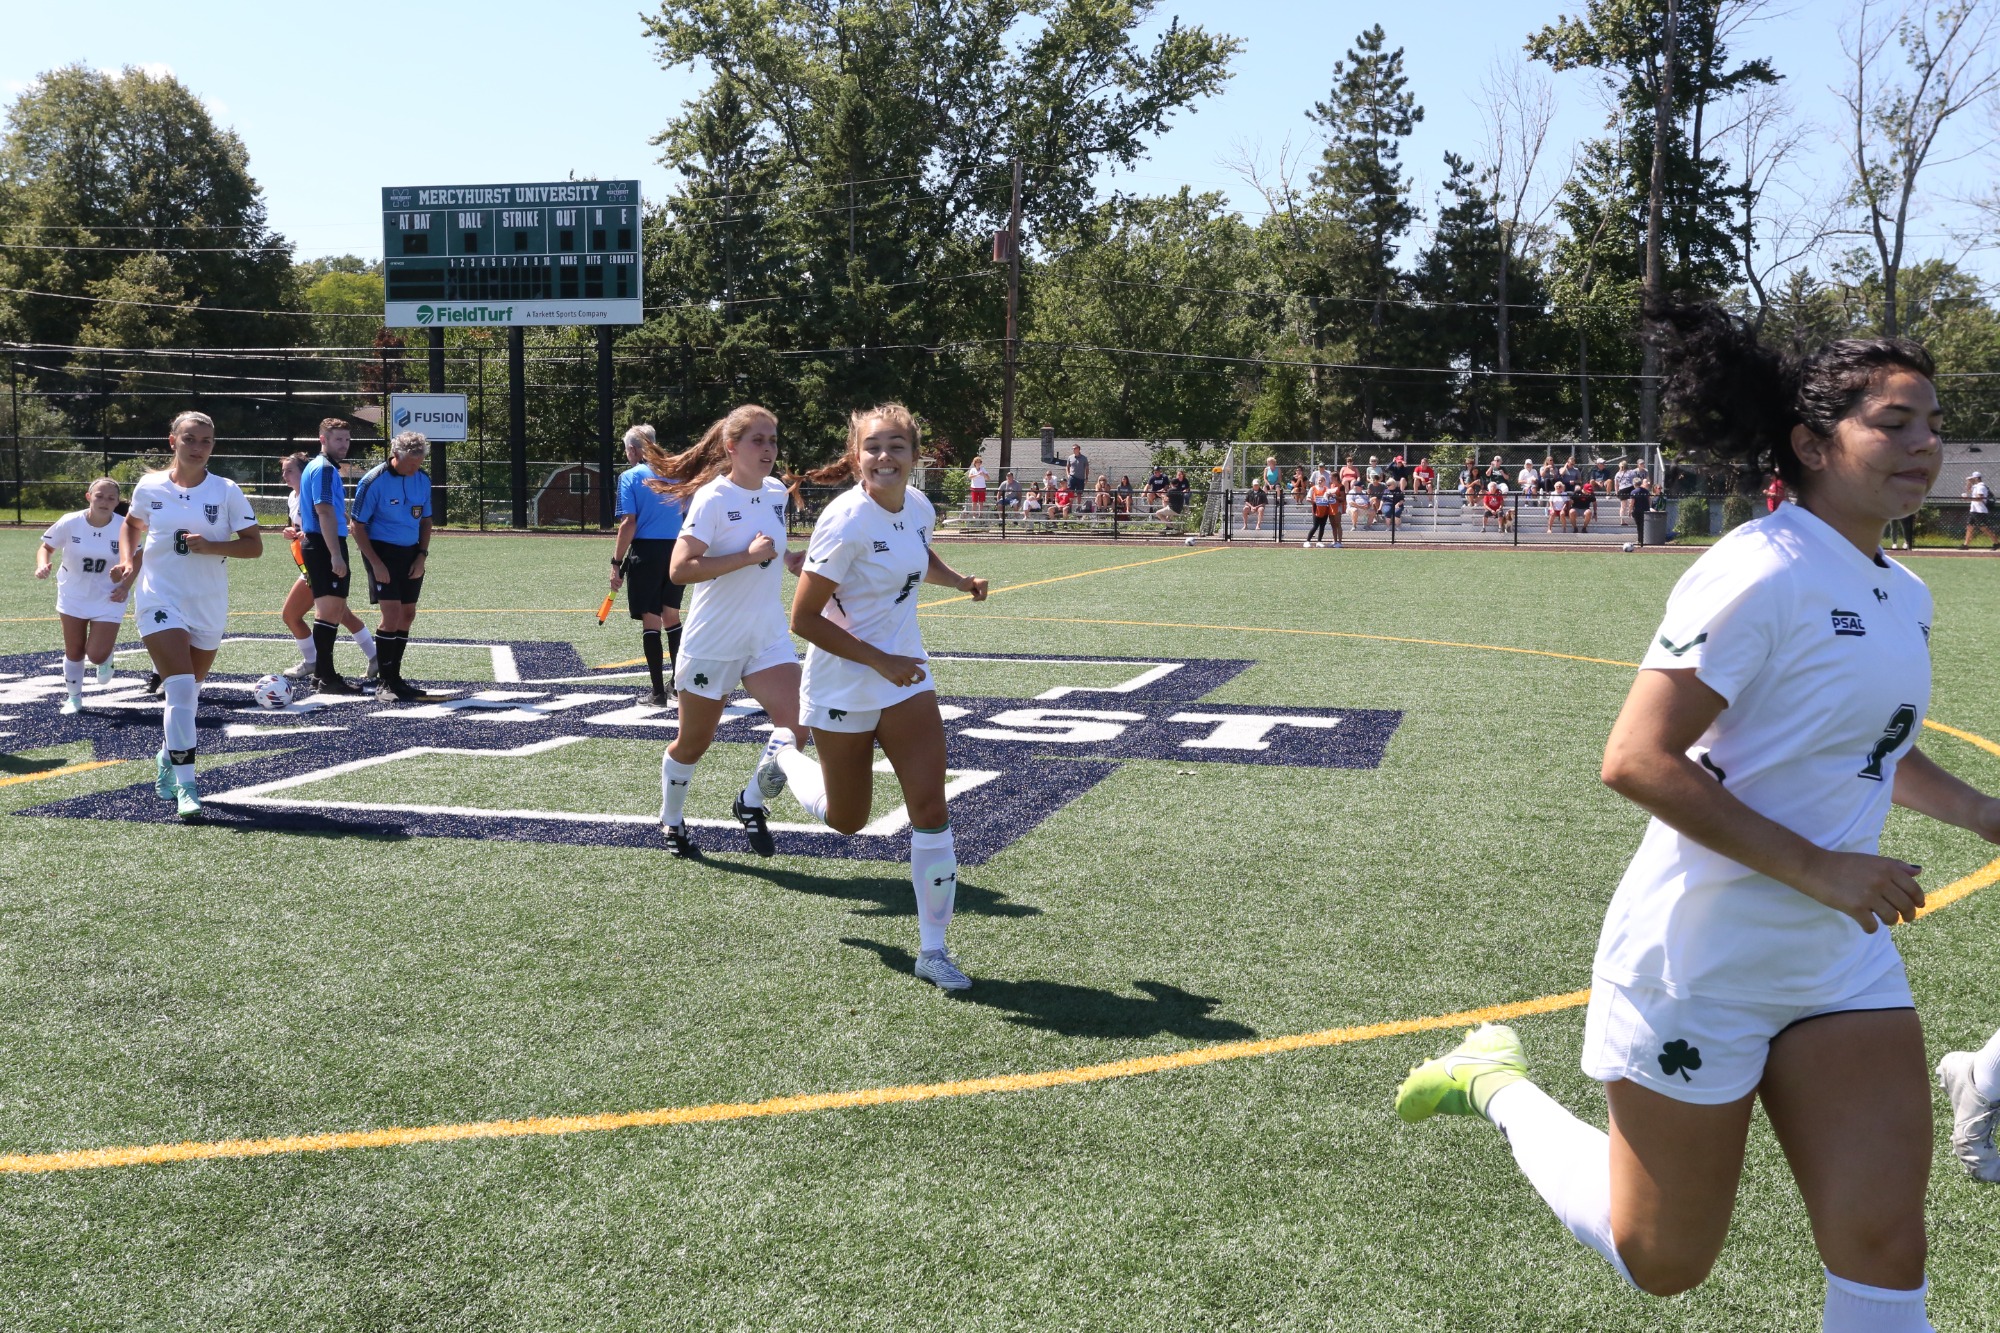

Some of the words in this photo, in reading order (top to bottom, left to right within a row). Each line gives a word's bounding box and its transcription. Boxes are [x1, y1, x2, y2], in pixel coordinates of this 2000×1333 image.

[419, 188, 511, 205] MERCYHURST
[515, 185, 599, 203] UNIVERSITY
[399, 214, 409, 230] AT
[414, 213, 430, 229] BAT
[458, 212, 481, 229] BALL
[502, 210, 538, 228] STRIKE
[556, 209, 576, 226] OUT
[596, 209, 602, 225] H
[622, 208, 627, 225] E
[451, 258, 454, 268] 1
[461, 259, 464, 268] 2
[471, 258, 475, 267] 3
[482, 258, 485, 267] 4
[492, 258, 495, 267] 5
[503, 257, 506, 267] 6
[512, 256, 517, 267] 7
[560, 255, 578, 265] RUNS
[586, 255, 601, 265] HITS
[609, 254, 634, 264] ERRORS
[437, 306, 513, 322] FieldTurf
[532, 310, 555, 318] Tarkett
[556, 310, 577, 318] Sports
[578, 309, 608, 318] Company
[414, 412, 464, 423] FUSION
[173, 528, 191, 556] 8
[82, 557, 107, 573] 20
[1831, 616, 1866, 631] PSAC
